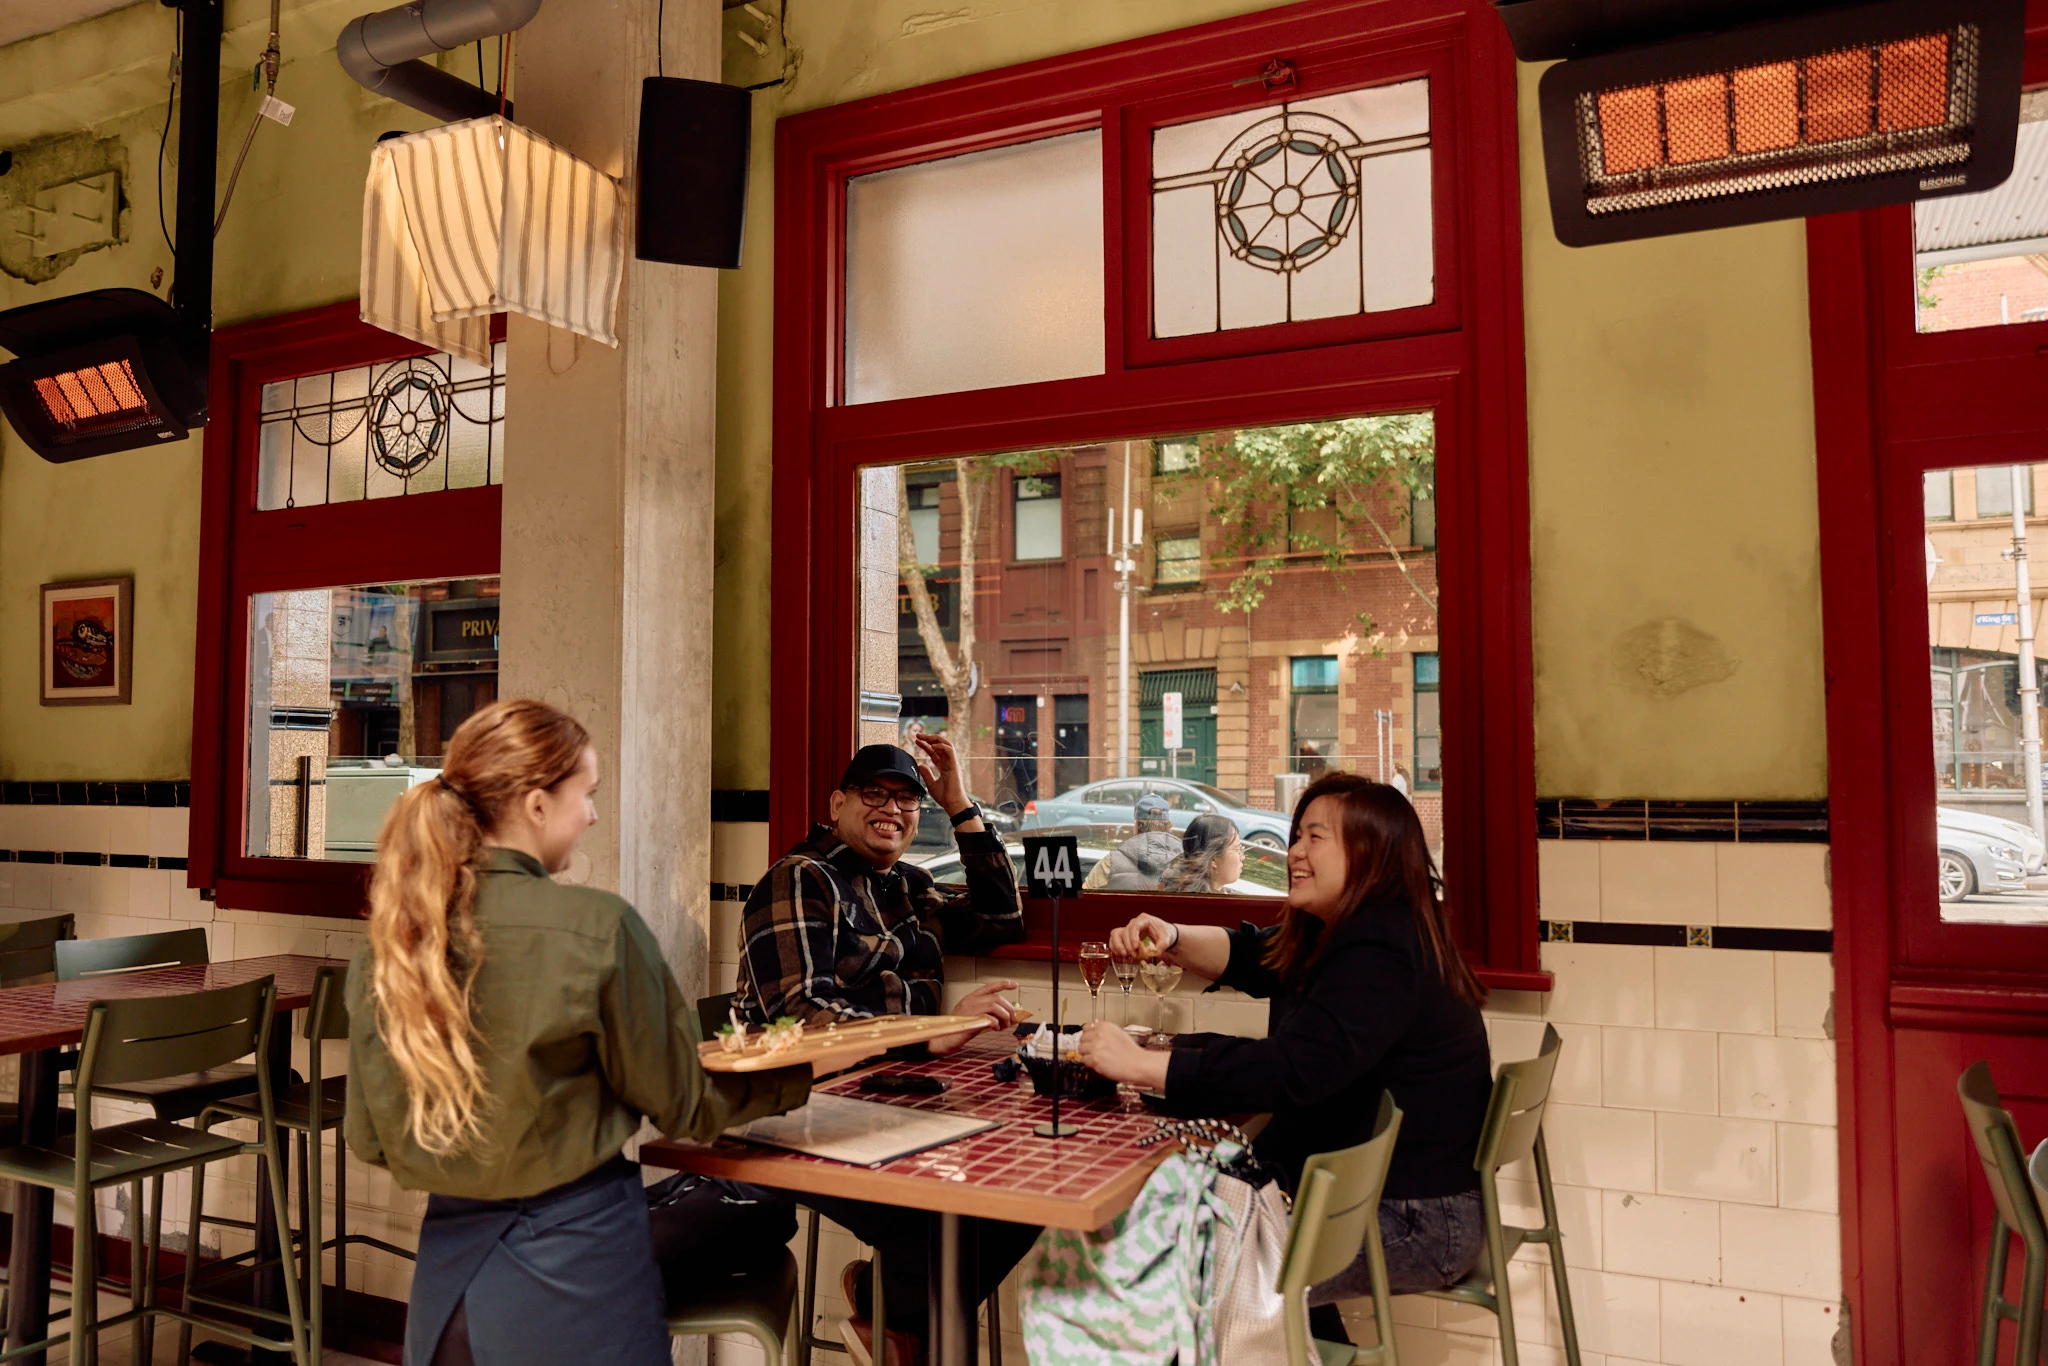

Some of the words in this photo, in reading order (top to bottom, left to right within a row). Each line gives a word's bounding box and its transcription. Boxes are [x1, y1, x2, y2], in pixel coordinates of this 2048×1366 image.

[1919, 175, 1967, 189] BROMIC
[1982, 615, 2001, 623] King
[1033, 845, 1075, 889] 44
